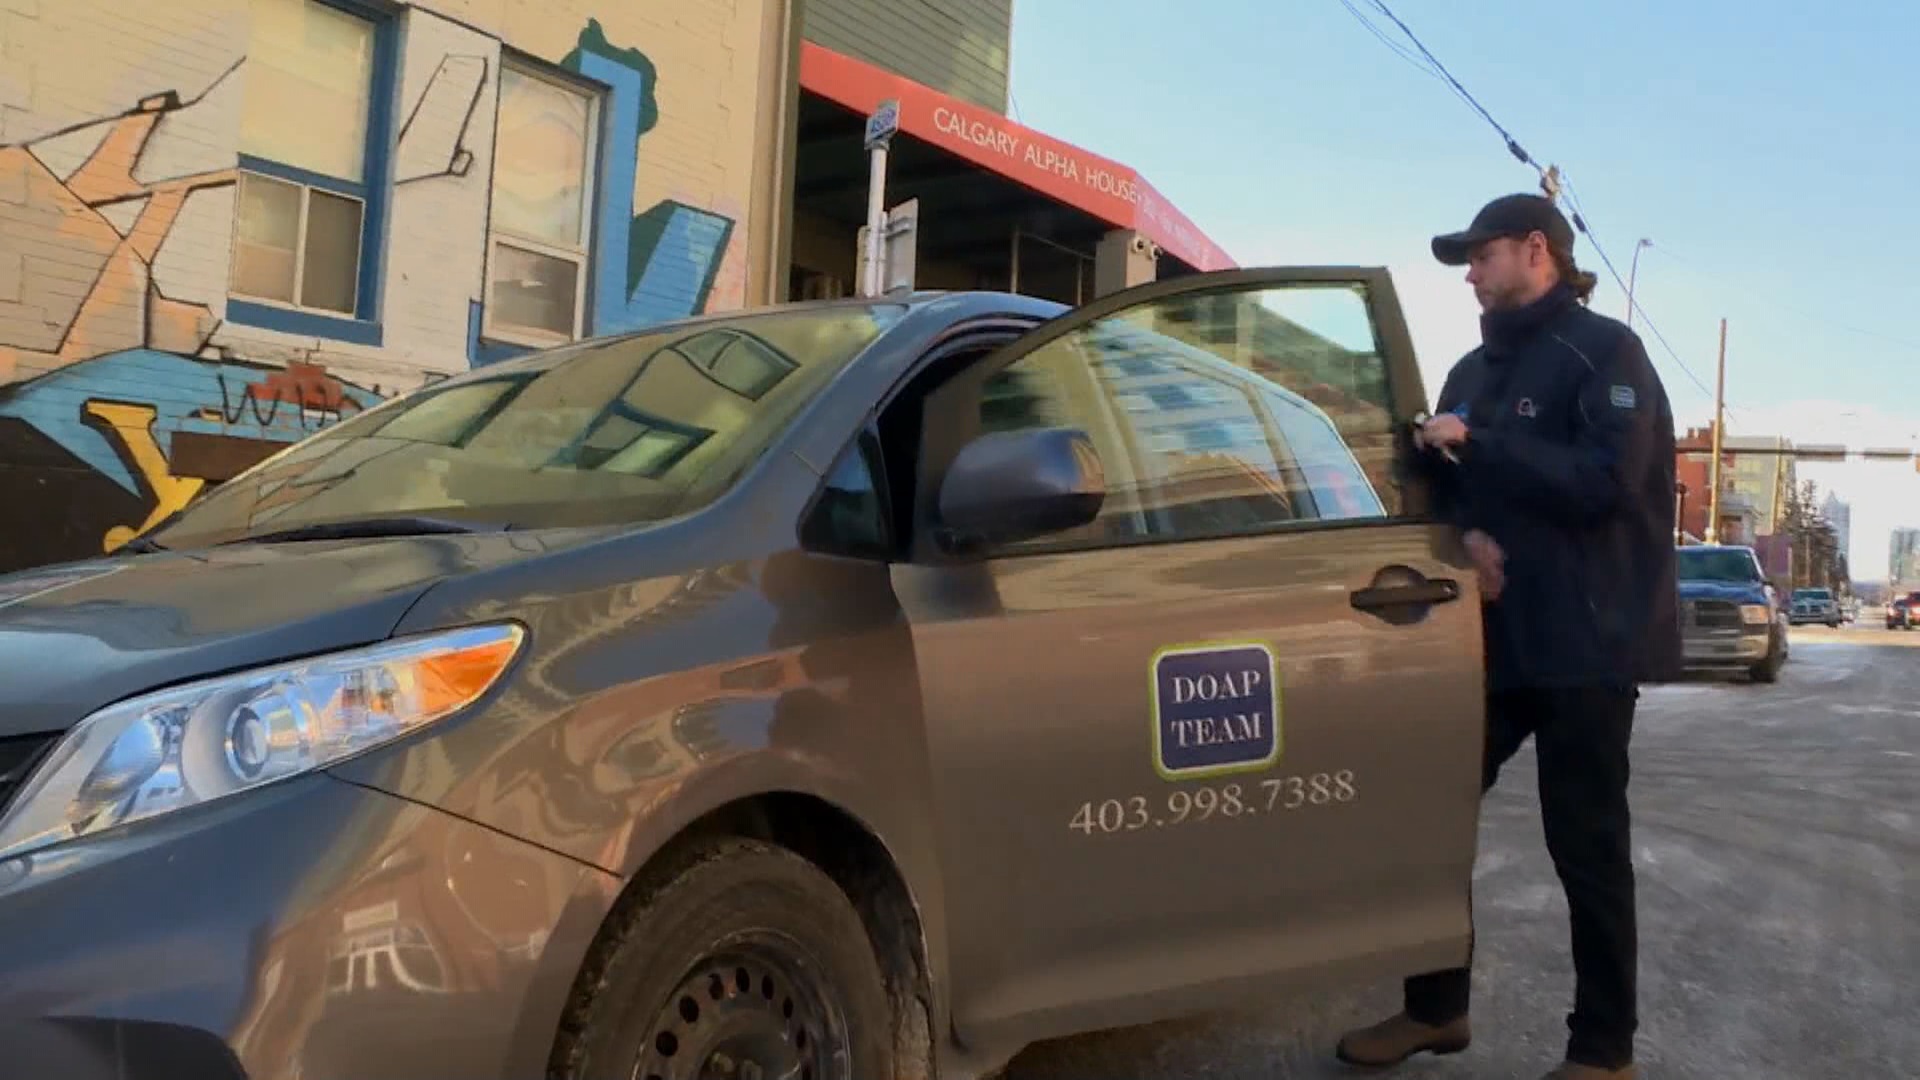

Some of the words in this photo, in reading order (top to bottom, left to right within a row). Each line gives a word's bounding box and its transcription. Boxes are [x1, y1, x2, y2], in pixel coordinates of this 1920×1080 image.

[934, 107, 1018, 156] CALGARY
[1024, 144, 1079, 180] ALPHA
[1085, 167, 1137, 204] HOUSE
[1172, 670, 1260, 704] DOAP
[1171, 712, 1263, 748] TEAM
[1069, 769, 1356, 835] 403.998.7388
